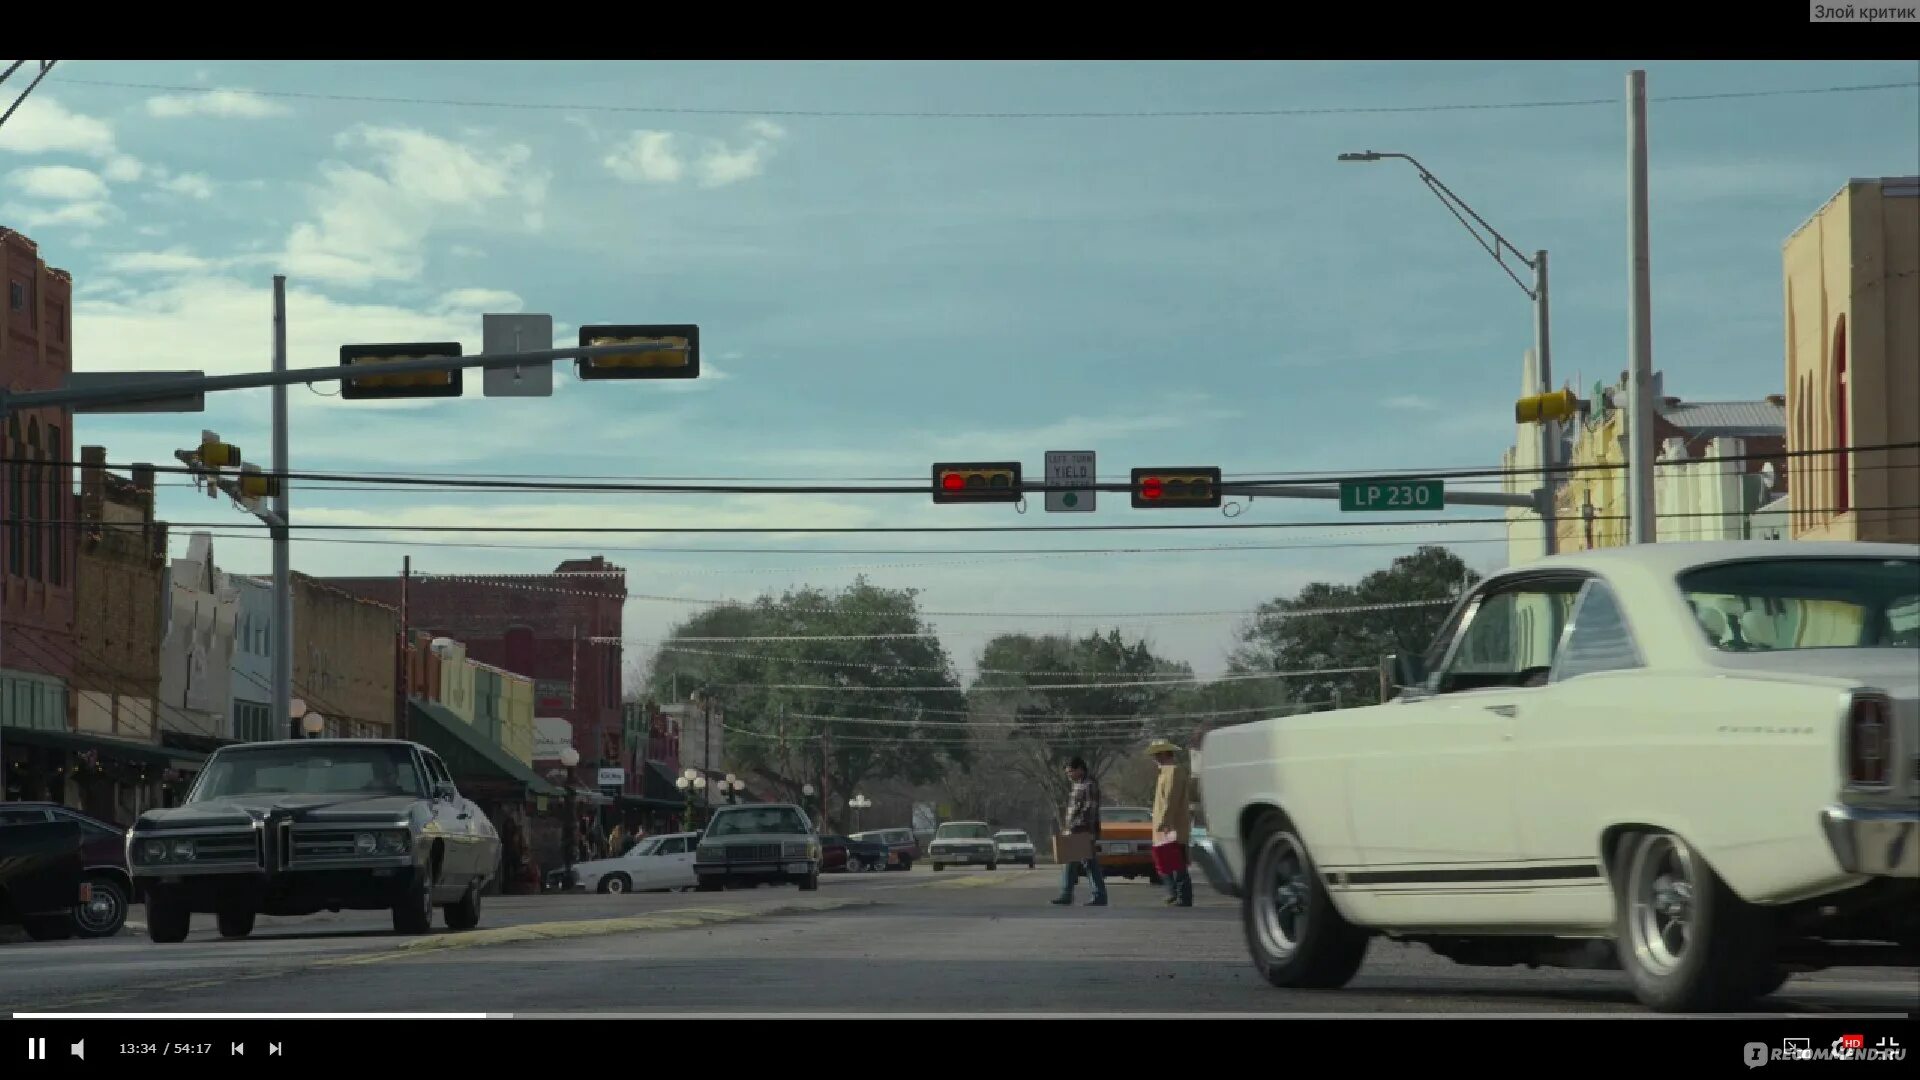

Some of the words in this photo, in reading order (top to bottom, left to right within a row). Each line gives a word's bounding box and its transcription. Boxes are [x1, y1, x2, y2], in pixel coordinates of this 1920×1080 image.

[1054, 465, 1087, 478] YIELD
[1355, 486, 1381, 505] LP
[1386, 485, 1430, 505] 230
